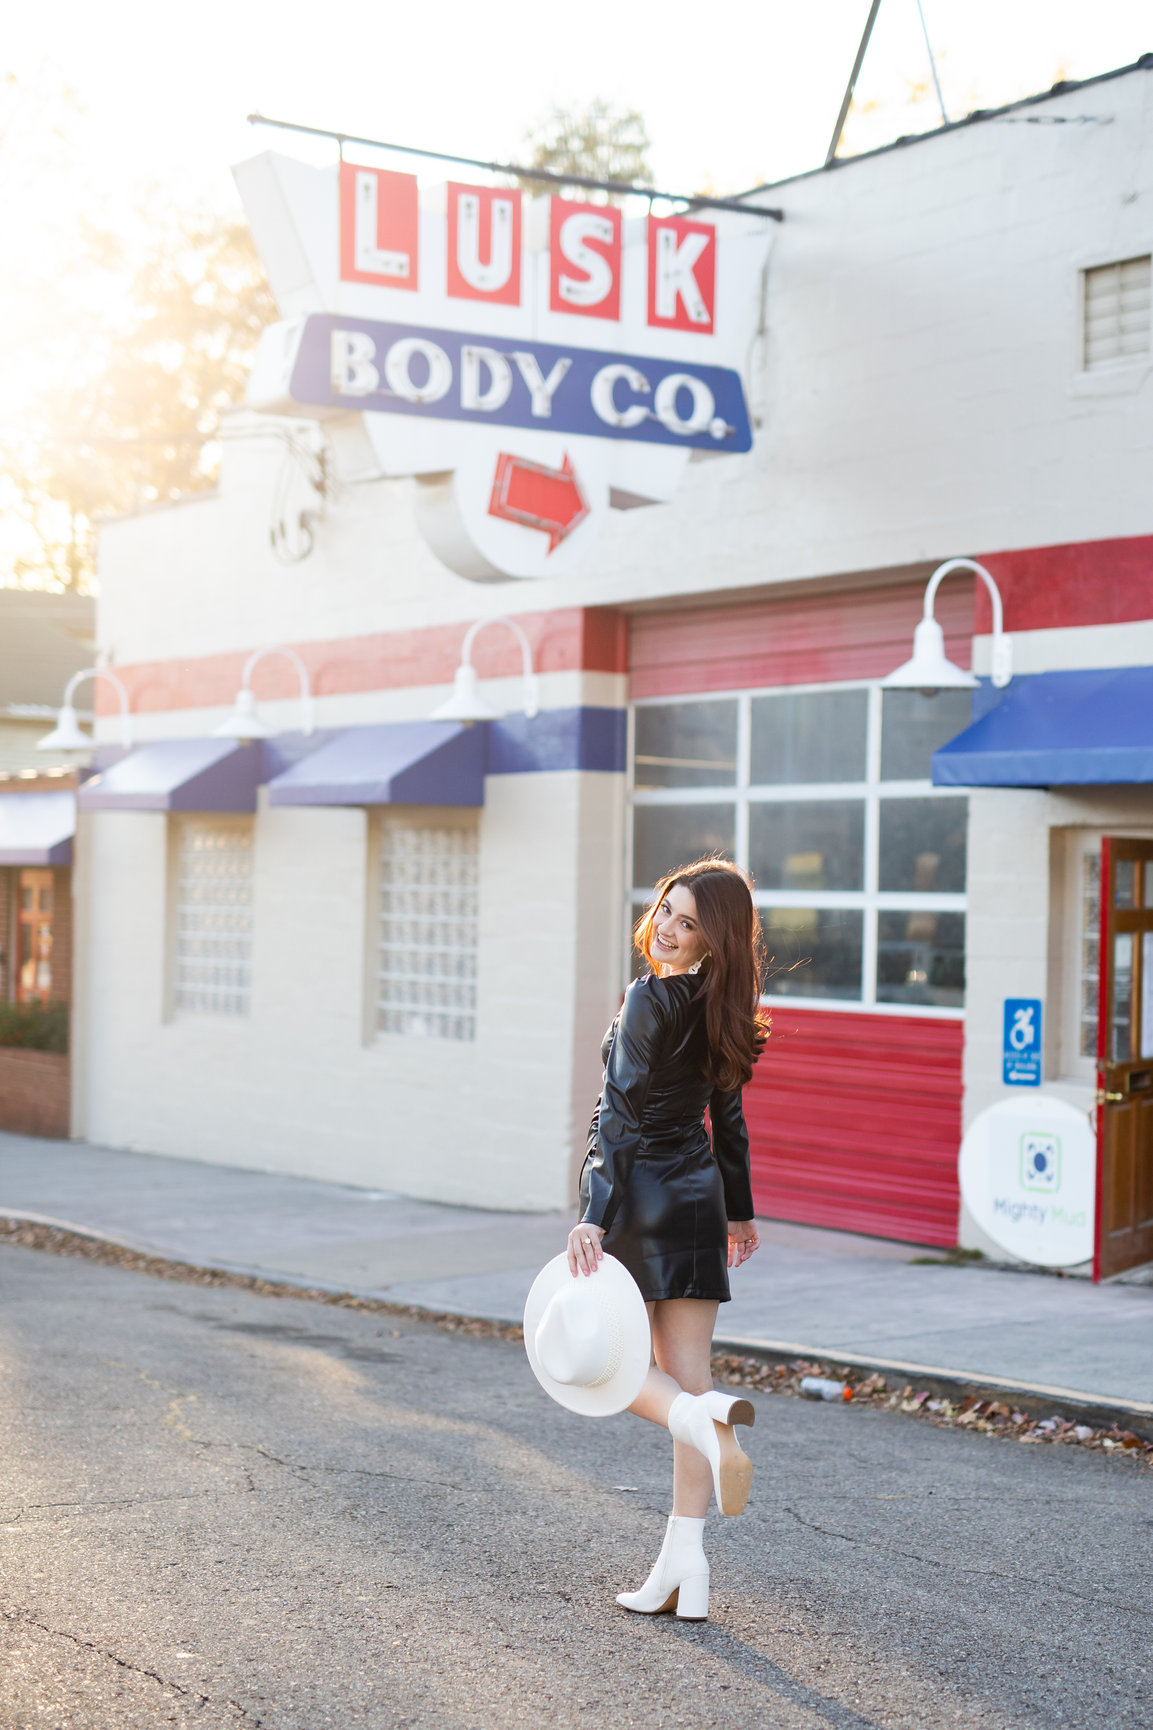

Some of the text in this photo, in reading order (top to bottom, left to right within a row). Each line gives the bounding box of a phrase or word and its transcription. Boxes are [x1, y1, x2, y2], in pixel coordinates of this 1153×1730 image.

[355, 172, 710, 324] LUSK
[331, 330, 729, 439] BODY CO.
[994, 1198, 1087, 1228] Mighty Mud
